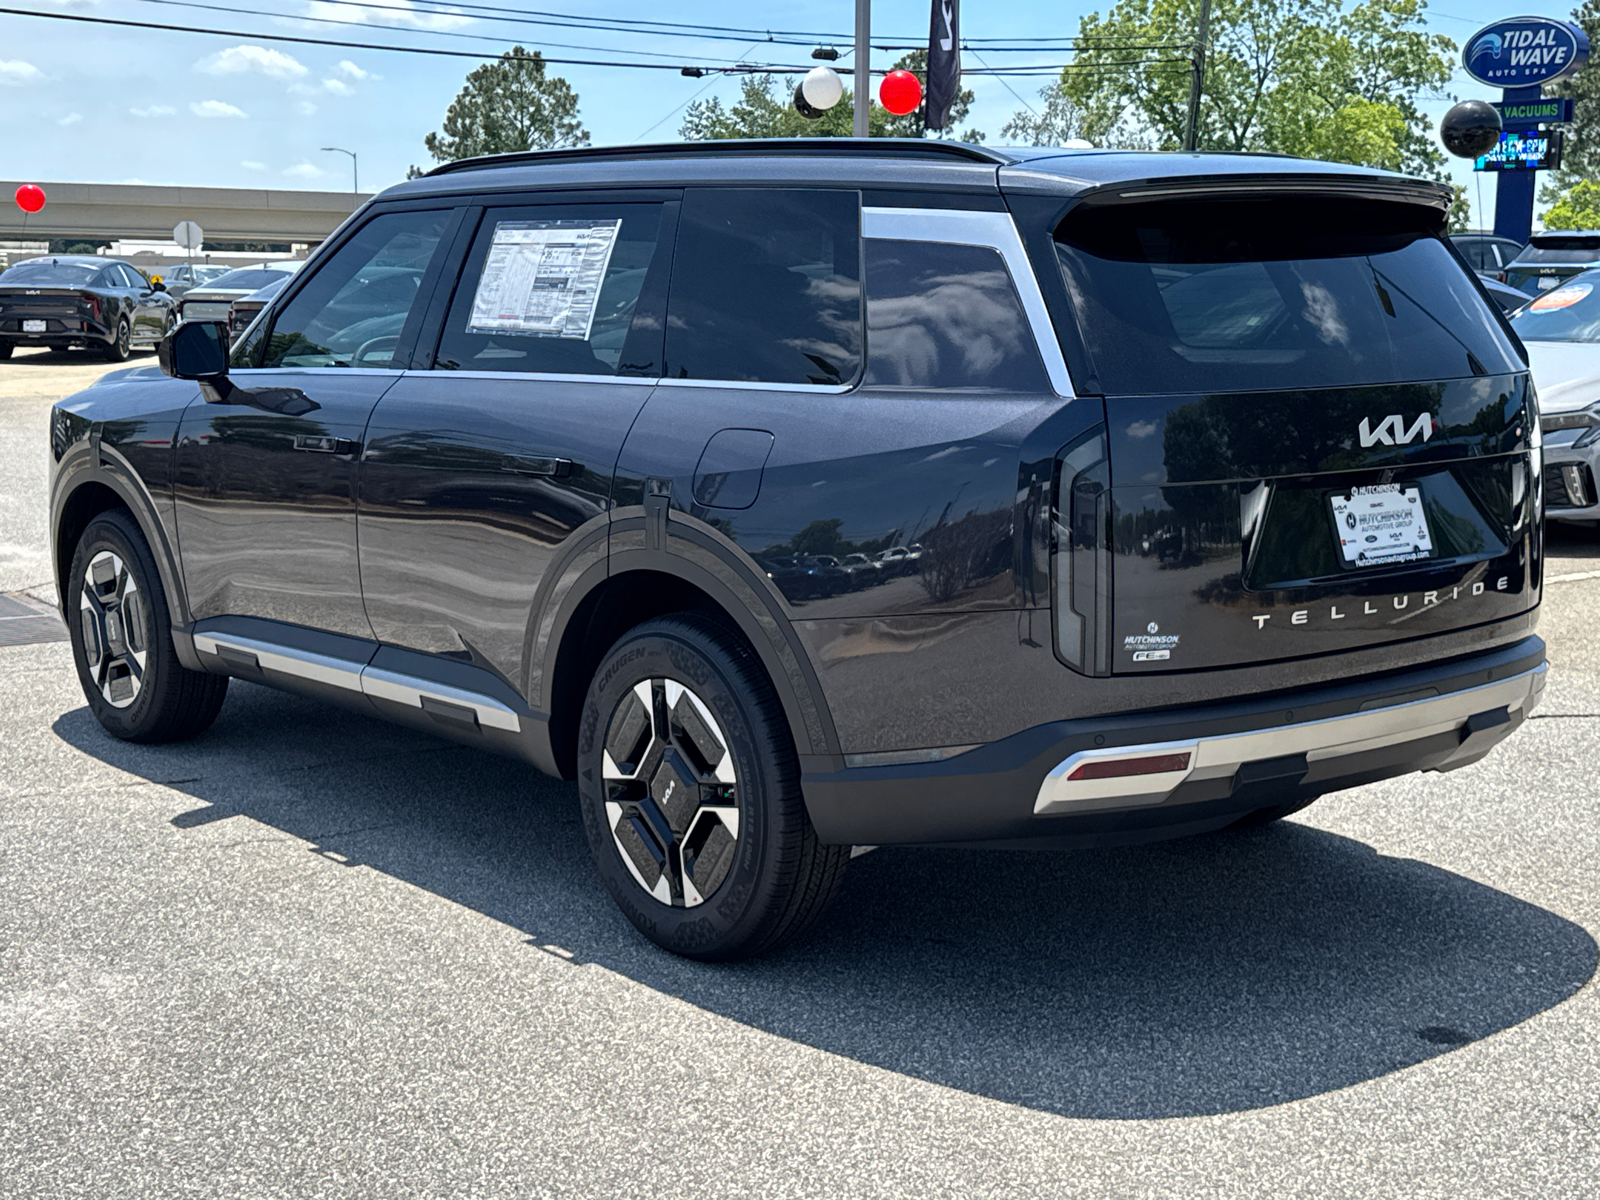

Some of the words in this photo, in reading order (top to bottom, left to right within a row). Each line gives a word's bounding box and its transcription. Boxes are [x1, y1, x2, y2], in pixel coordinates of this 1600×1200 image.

[1503, 28, 1557, 49] TIDAL
[1510, 46, 1568, 67] WAVE
[1487, 69, 1517, 77] AUTO
[1524, 68, 1547, 76] SPA
[1504, 103, 1558, 118] VACUUMS
[1358, 412, 1432, 448] KIA
[1359, 483, 1401, 496] HUTCHINSON
[1359, 508, 1413, 525] HUTCHINSON
[1361, 522, 1394, 533] AUTOMOTIVE
[1395, 519, 1413, 529] GROUP
[1252, 576, 1509, 630] TELLURIDE
[1124, 635, 1179, 644] HUTCHINSON
[599, 646, 646, 693] CRUGEN
[130, 678, 150, 723] KUMHO
[662, 779, 675, 805] KIA
